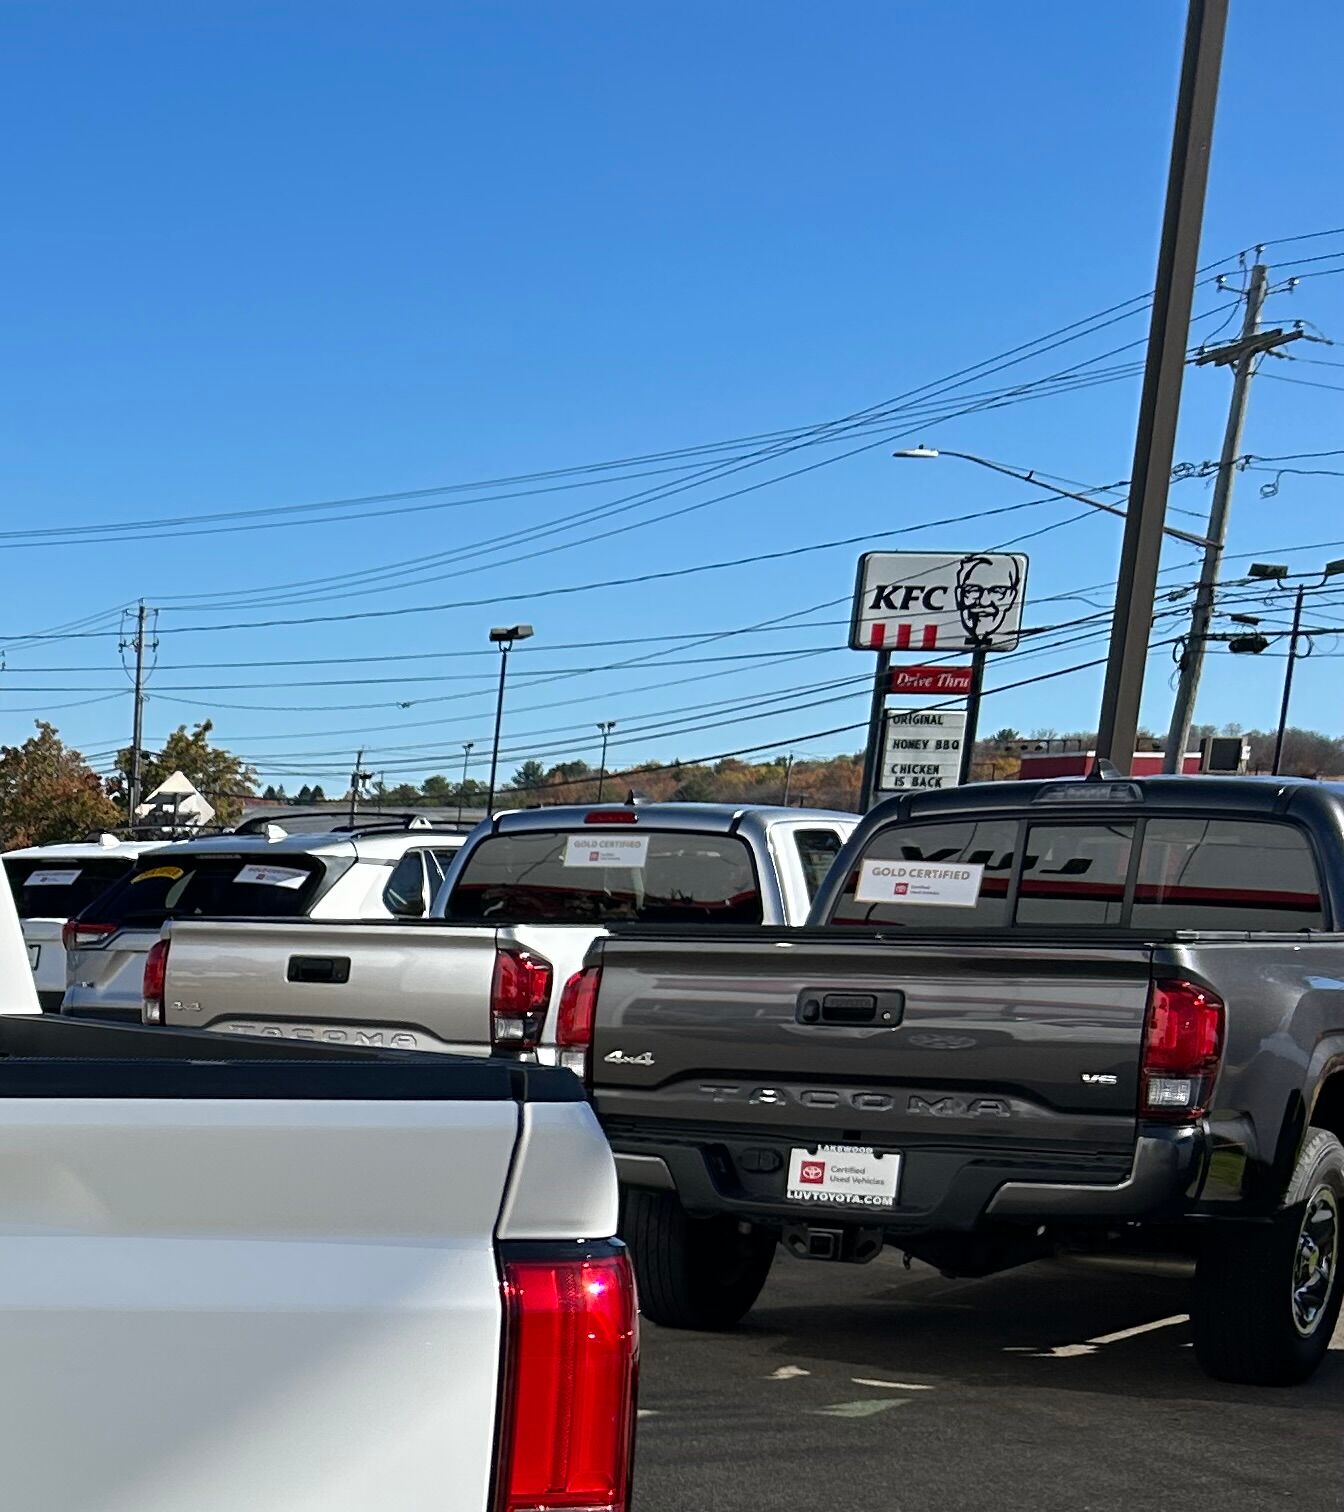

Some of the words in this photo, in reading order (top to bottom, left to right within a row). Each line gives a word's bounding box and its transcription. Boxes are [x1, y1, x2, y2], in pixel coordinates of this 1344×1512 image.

[868, 585, 948, 610] KFC
[896, 673, 932, 687] Drive
[936, 673, 969, 687] Thru
[892, 714, 943, 725] ORIGINAL
[892, 739, 929, 750] HONEY
[935, 740, 960, 750] BBQ
[891, 764, 940, 775] CHICKEN
[894, 776, 905, 787] IS
[912, 777, 943, 788] BACK
[871, 867, 906, 877] GOLD
[908, 868, 970, 880] CERTIFIED
[698, 1084, 1012, 1118] TACOMA
[830, 1165, 866, 1175] Certified
[787, 1190, 893, 1206] LUVTOYOTA.COM
